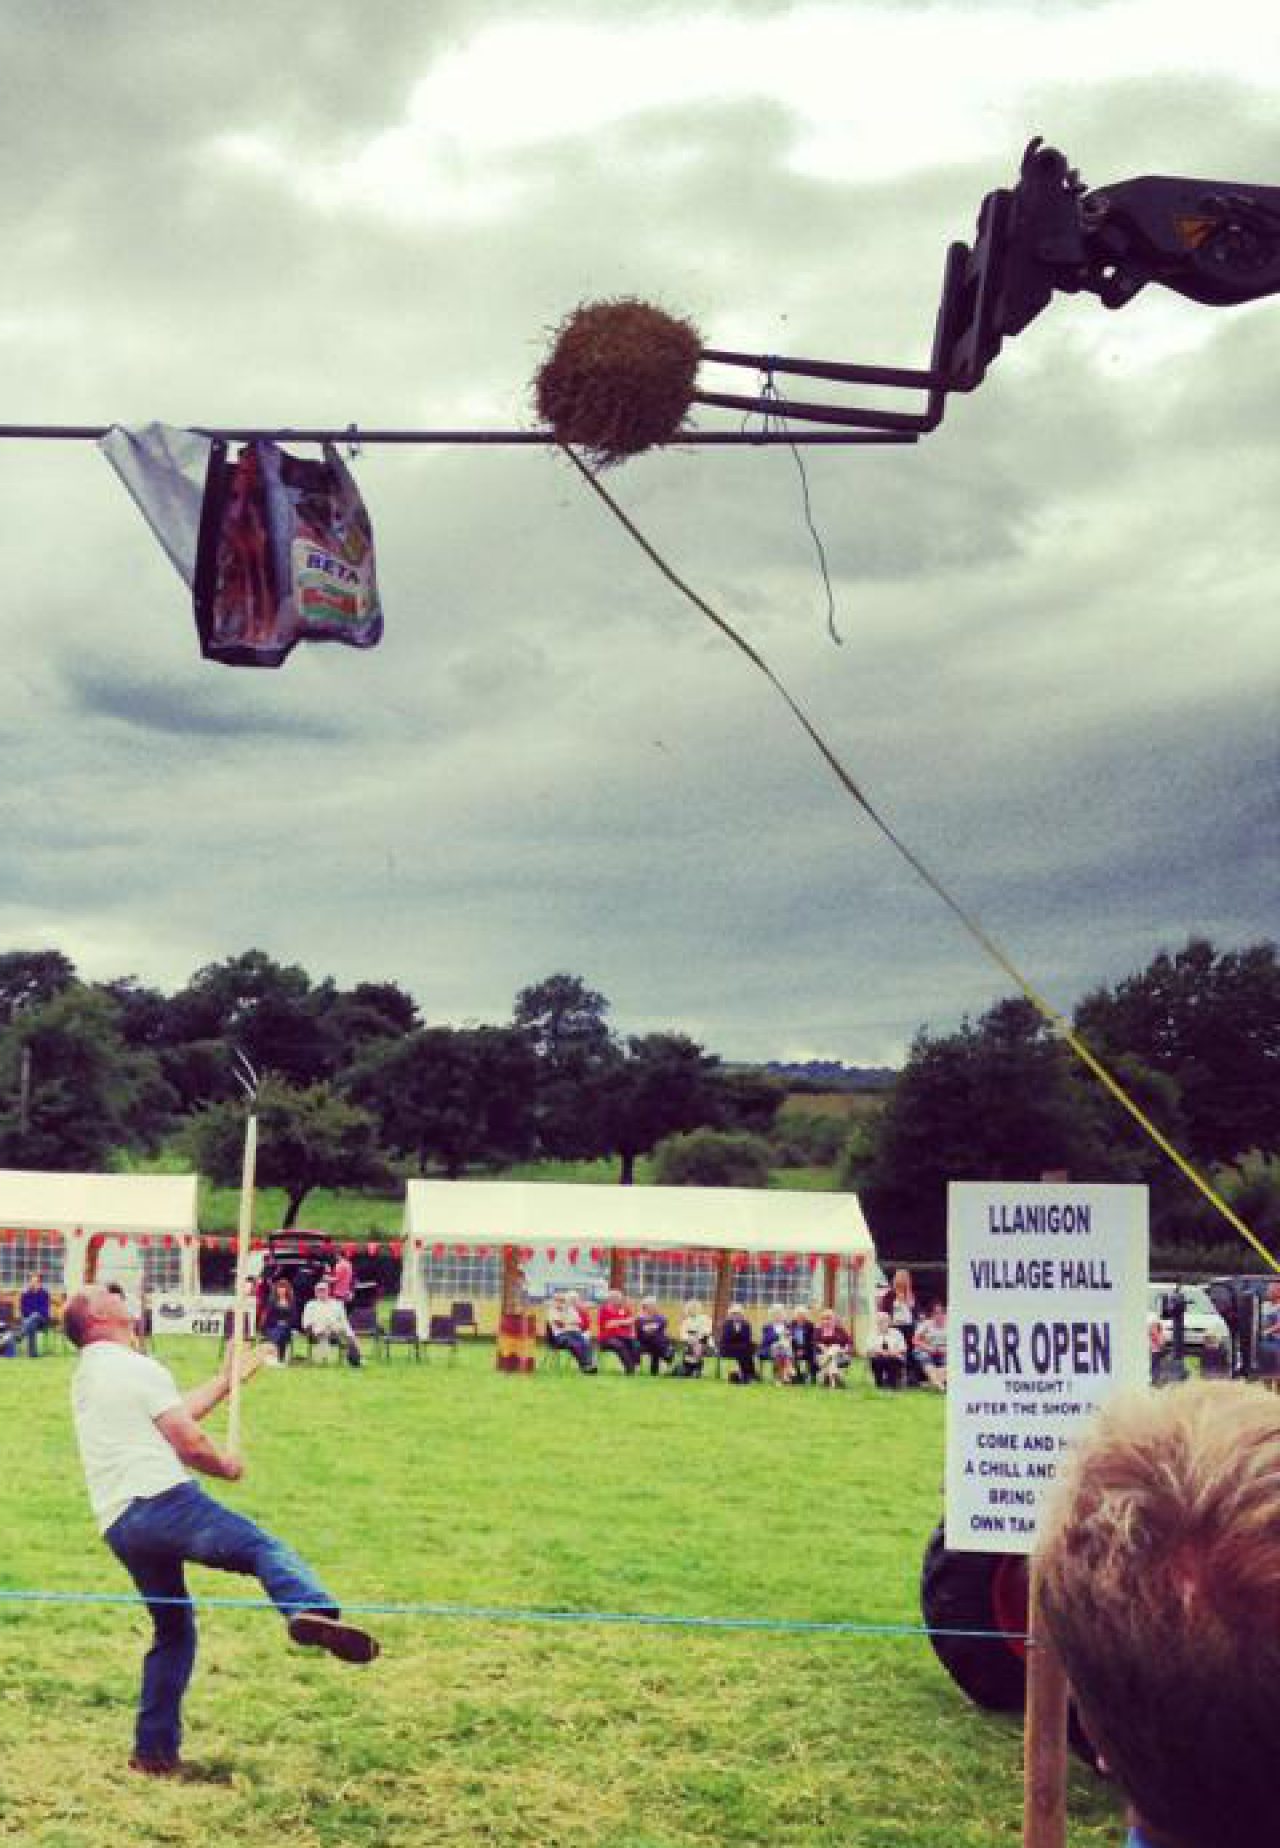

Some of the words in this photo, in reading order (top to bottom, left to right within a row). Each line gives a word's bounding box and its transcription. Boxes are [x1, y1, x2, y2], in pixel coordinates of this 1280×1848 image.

[989, 1204, 1091, 1234] LLANIGON
[970, 1260, 1054, 1289] VILLAGE
[1060, 1260, 1112, 1289] HALL
[962, 1321, 1021, 1374] BAR
[1031, 1321, 1111, 1374] OPEN
[1005, 1380, 1064, 1393] TONIGHT
[966, 1402, 1008, 1415] AFTER
[1012, 1402, 1038, 1415] THE
[1042, 1402, 1081, 1416] SHOW
[977, 1434, 1019, 1450] COME
[1024, 1436, 1054, 1451] AND
[964, 1459, 974, 1475] A
[978, 1460, 1021, 1478] CHILL
[1026, 1463, 1057, 1479] AND
[989, 1488, 1036, 1504] BRING
[970, 1514, 1005, 1531] OWN
